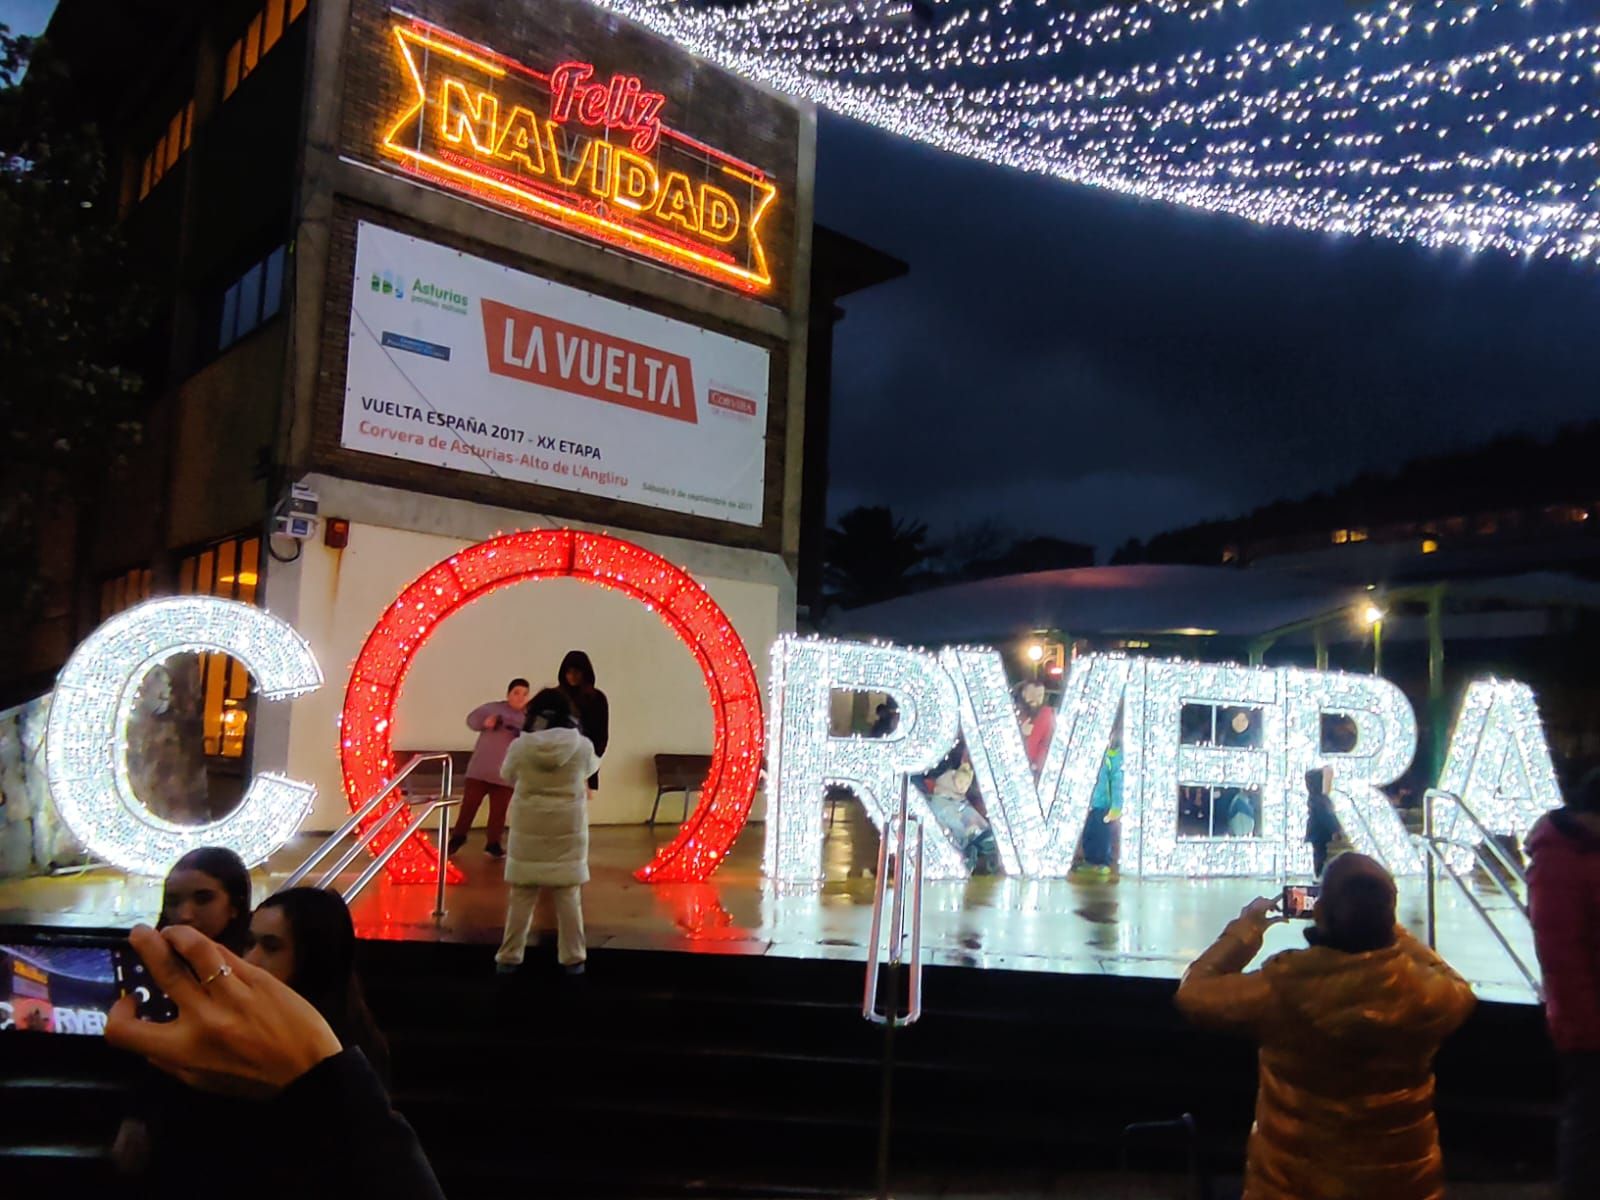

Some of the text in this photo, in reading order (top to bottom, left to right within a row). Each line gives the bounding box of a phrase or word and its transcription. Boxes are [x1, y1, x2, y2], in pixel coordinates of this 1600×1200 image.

[550, 61, 666, 154] Feliz
[440, 78, 742, 243] NAVIDAD
[412, 277, 468, 307] Asturias
[503, 317, 548, 373] LA
[555, 331, 681, 409] VUELTA
[359, 420, 425, 446] Corvera
[428, 435, 447, 450] de
[552, 460, 569, 475] de
[572, 464, 629, 486] L'Angliru
[361, 396, 423, 422] VUELTA
[427, 411, 488, 436] ESPAÑA
[491, 424, 525, 444] 2017
[536, 434, 557, 451] XX
[559, 439, 602, 461] ETAPA
[45, 526, 1565, 890] CORVERA
